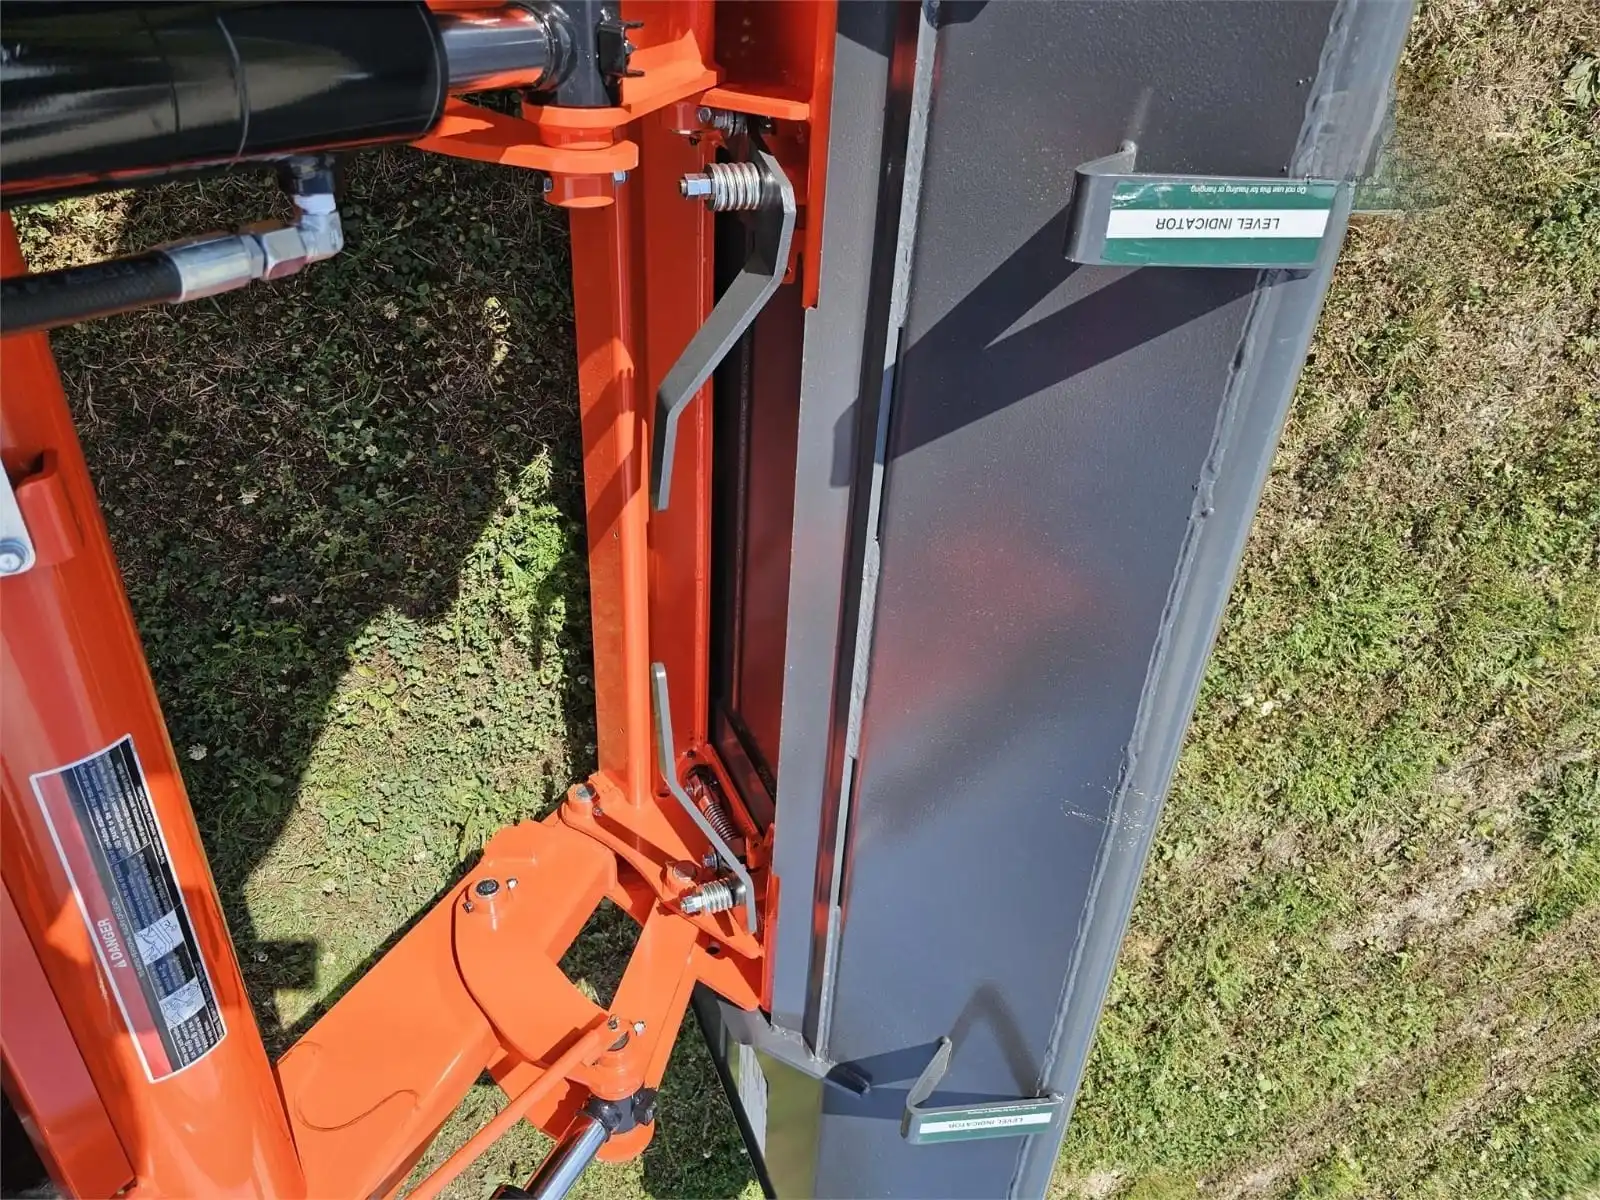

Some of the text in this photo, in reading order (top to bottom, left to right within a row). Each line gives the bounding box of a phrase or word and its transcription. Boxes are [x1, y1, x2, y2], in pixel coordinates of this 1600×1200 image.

[1250, 186, 1259, 194] for
[1260, 186, 1272, 194] this
[1155, 217, 1280, 230] LEVEL INDICATOR
[97, 918, 123, 960] DANGER
[948, 1117, 1024, 1129] LEVEL INDICATOR
